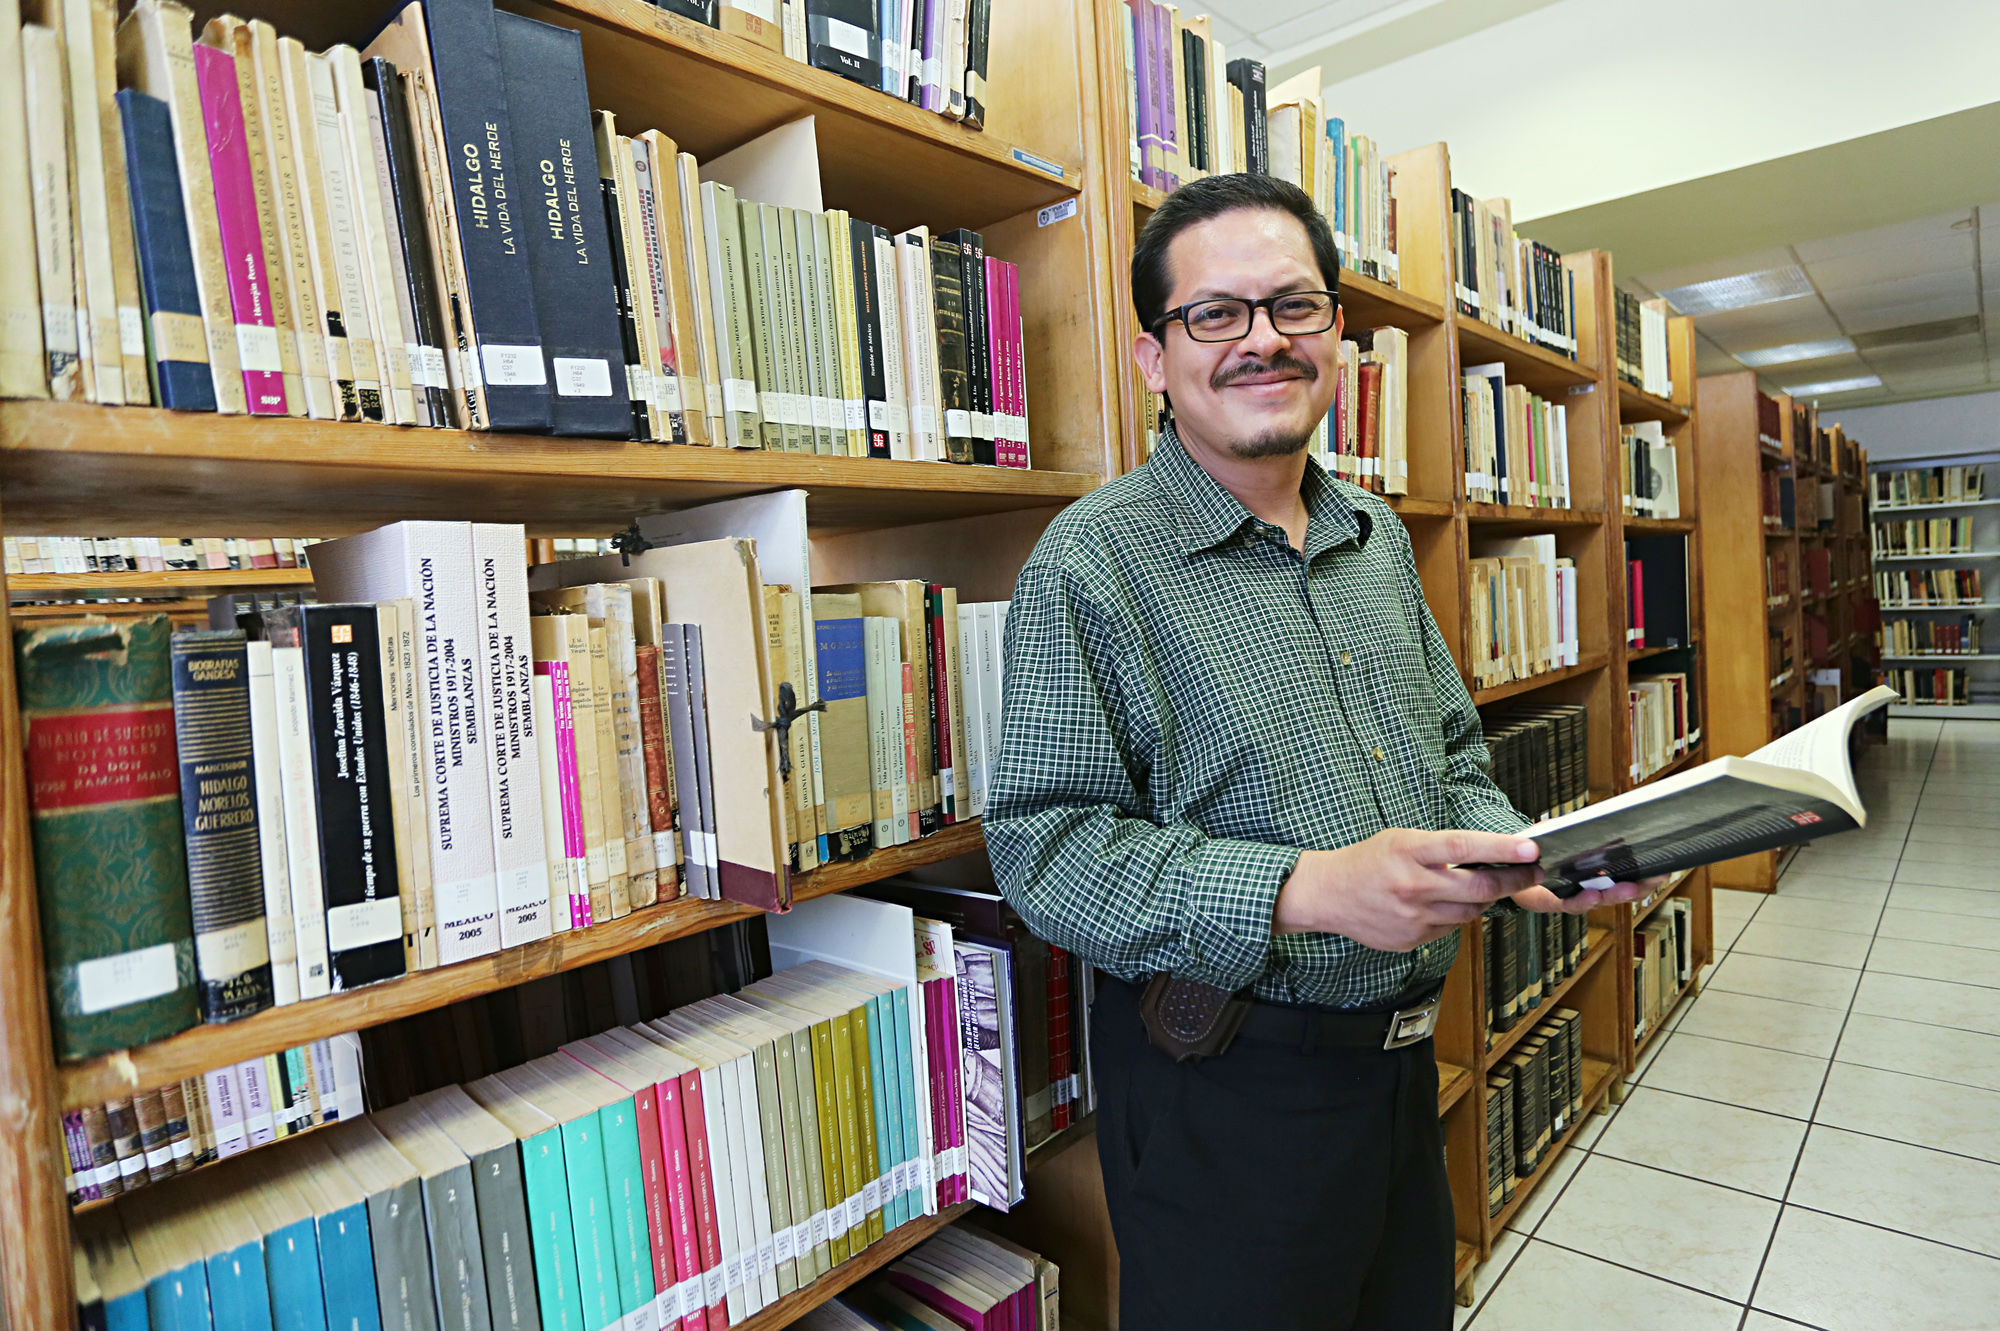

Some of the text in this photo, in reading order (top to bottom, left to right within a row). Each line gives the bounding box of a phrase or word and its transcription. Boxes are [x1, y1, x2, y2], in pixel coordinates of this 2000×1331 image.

[840, 54, 861, 69] Vol. II
[1155, 123, 1160, 134] 1
[1169, 131, 1176, 141] 2
[463, 143, 490, 229] HIDALGO
[485, 122, 516, 254] LA VIDA DEL HEROE
[540, 160, 564, 240] HIDALGO
[560, 138, 589, 264] LA VIDA DEL HEROE
[301, 293, 315, 331] ALGO
[869, 345, 874, 353] de
[347, 651, 363, 710] (1846-1848)
[389, 672, 399, 711] Memorias
[404, 672, 413, 699] México
[407, 700, 414, 710] de
[419, 557, 453, 850] SUPREMA CORTE DE JUSTICIA DE LA NACIÓN
[443, 638, 463, 767] MINISTROS 1917-2004
[461, 658, 477, 745] SEMBLANZAS
[482, 558, 513, 839] SUPREMA CORTE DE JUSTICIA DE LA NACIÓN
[502, 636, 521, 759] MINISTROS 1917-2004
[518, 655, 534, 737] SEMBLANZAS
[330, 652, 350, 779] Josefina Zoraida Vázquez
[808, 695, 818, 736] MOREOS
[903, 692, 915, 724] MORELOS
[38, 723, 168, 749] DIARIO DE SUCESOS
[351, 711, 364, 745] Unidos
[408, 711, 417, 751] consulados
[353, 747, 367, 783] Estados
[411, 753, 420, 784] primeros
[813, 756, 821, 774] JOSE
[200, 776, 248, 795] HIDALGO
[358, 786, 369, 803] con
[412, 785, 421, 798] Los
[801, 773, 809, 808] VIRGINIA
[198, 792, 250, 813] MORELOS
[195, 808, 255, 831] GUERRERO
[360, 805, 374, 837] guerra
[361, 839, 372, 850] su
[362, 851, 373, 863] de
[363, 865, 376, 897] tiempo
[517, 911, 538, 924] 2005
[458, 927, 483, 942] 2005
[841, 1028, 849, 1039] 7
[857, 1019, 865, 1029] 7
[820, 1034, 828, 1045] 7
[762, 1058, 770, 1070] 6
[782, 1048, 790, 1059] 6
[665, 1090, 673, 1102] 4
[689, 1080, 697, 1092] 4
[641, 1099, 649, 1110] 4
[541, 1145, 549, 1158] 3
[491, 1163, 501, 1177] 2
[447, 1188, 457, 1202] 2
[389, 1203, 399, 1217] 2
